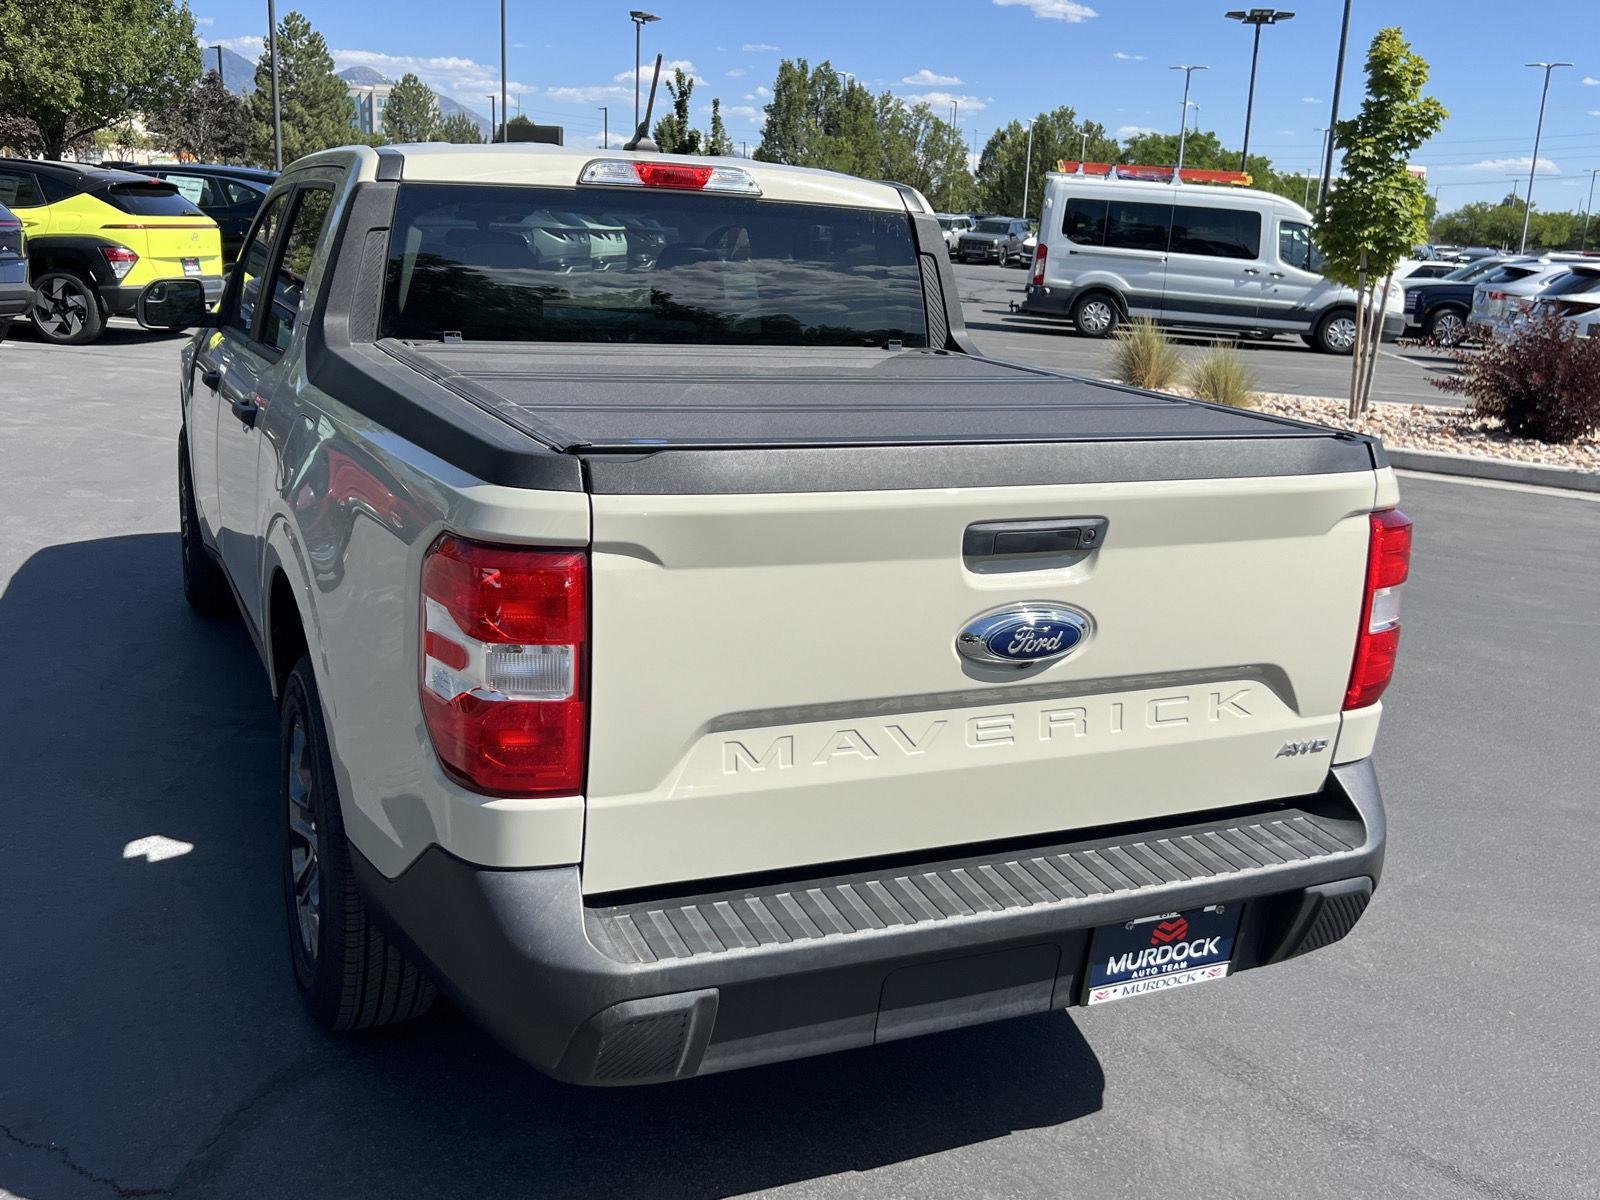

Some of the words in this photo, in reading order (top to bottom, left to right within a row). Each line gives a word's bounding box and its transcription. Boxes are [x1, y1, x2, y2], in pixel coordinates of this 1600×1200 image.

[1007, 625, 1064, 654] Ford
[721, 688, 1254, 775] MAVERICK
[1274, 738, 1330, 759] AWD
[1106, 935, 1221, 975] MURDOCK
[1131, 966, 1159, 979] AUTO
[1161, 960, 1188, 973] TEAM
[1121, 972, 1197, 996] MURDOCK
